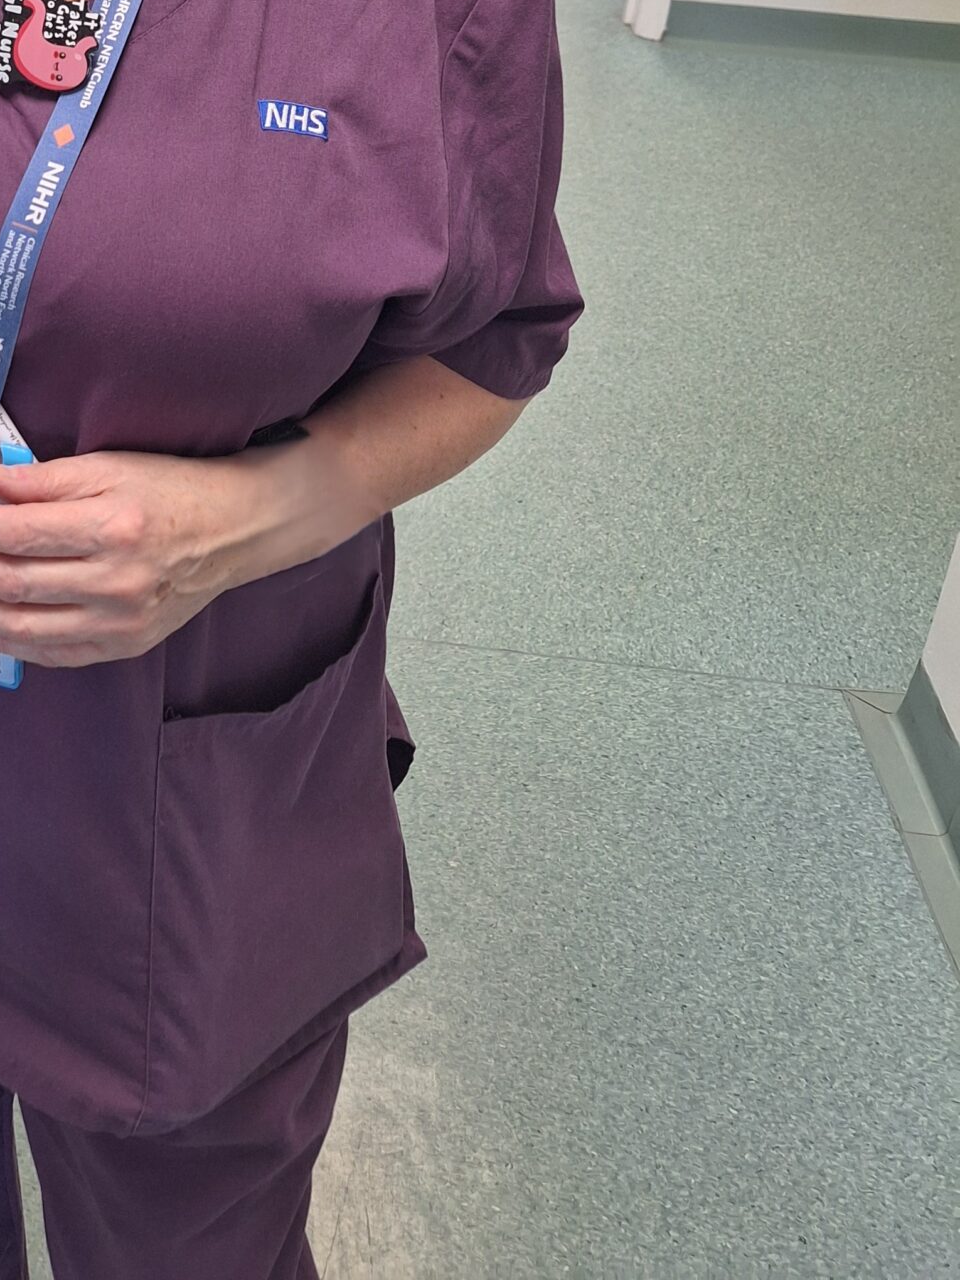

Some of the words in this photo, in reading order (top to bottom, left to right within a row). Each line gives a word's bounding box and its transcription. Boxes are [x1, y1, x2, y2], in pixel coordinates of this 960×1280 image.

[43, 31, 54, 39] a
[45, 12, 57, 28] be
[54, 4, 70, 39] Guts
[65, 0, 85, 48] Takes
[84, 12, 99, 30] It
[264, 102, 326, 134] NHS
[25, 161, 65, 226] NIHR
[4, 229, 15, 248] and
[7, 233, 26, 272] Network
[18, 236, 35, 270] Clinical
[0, 274, 13, 300] North
[7, 270, 25, 310] Research
